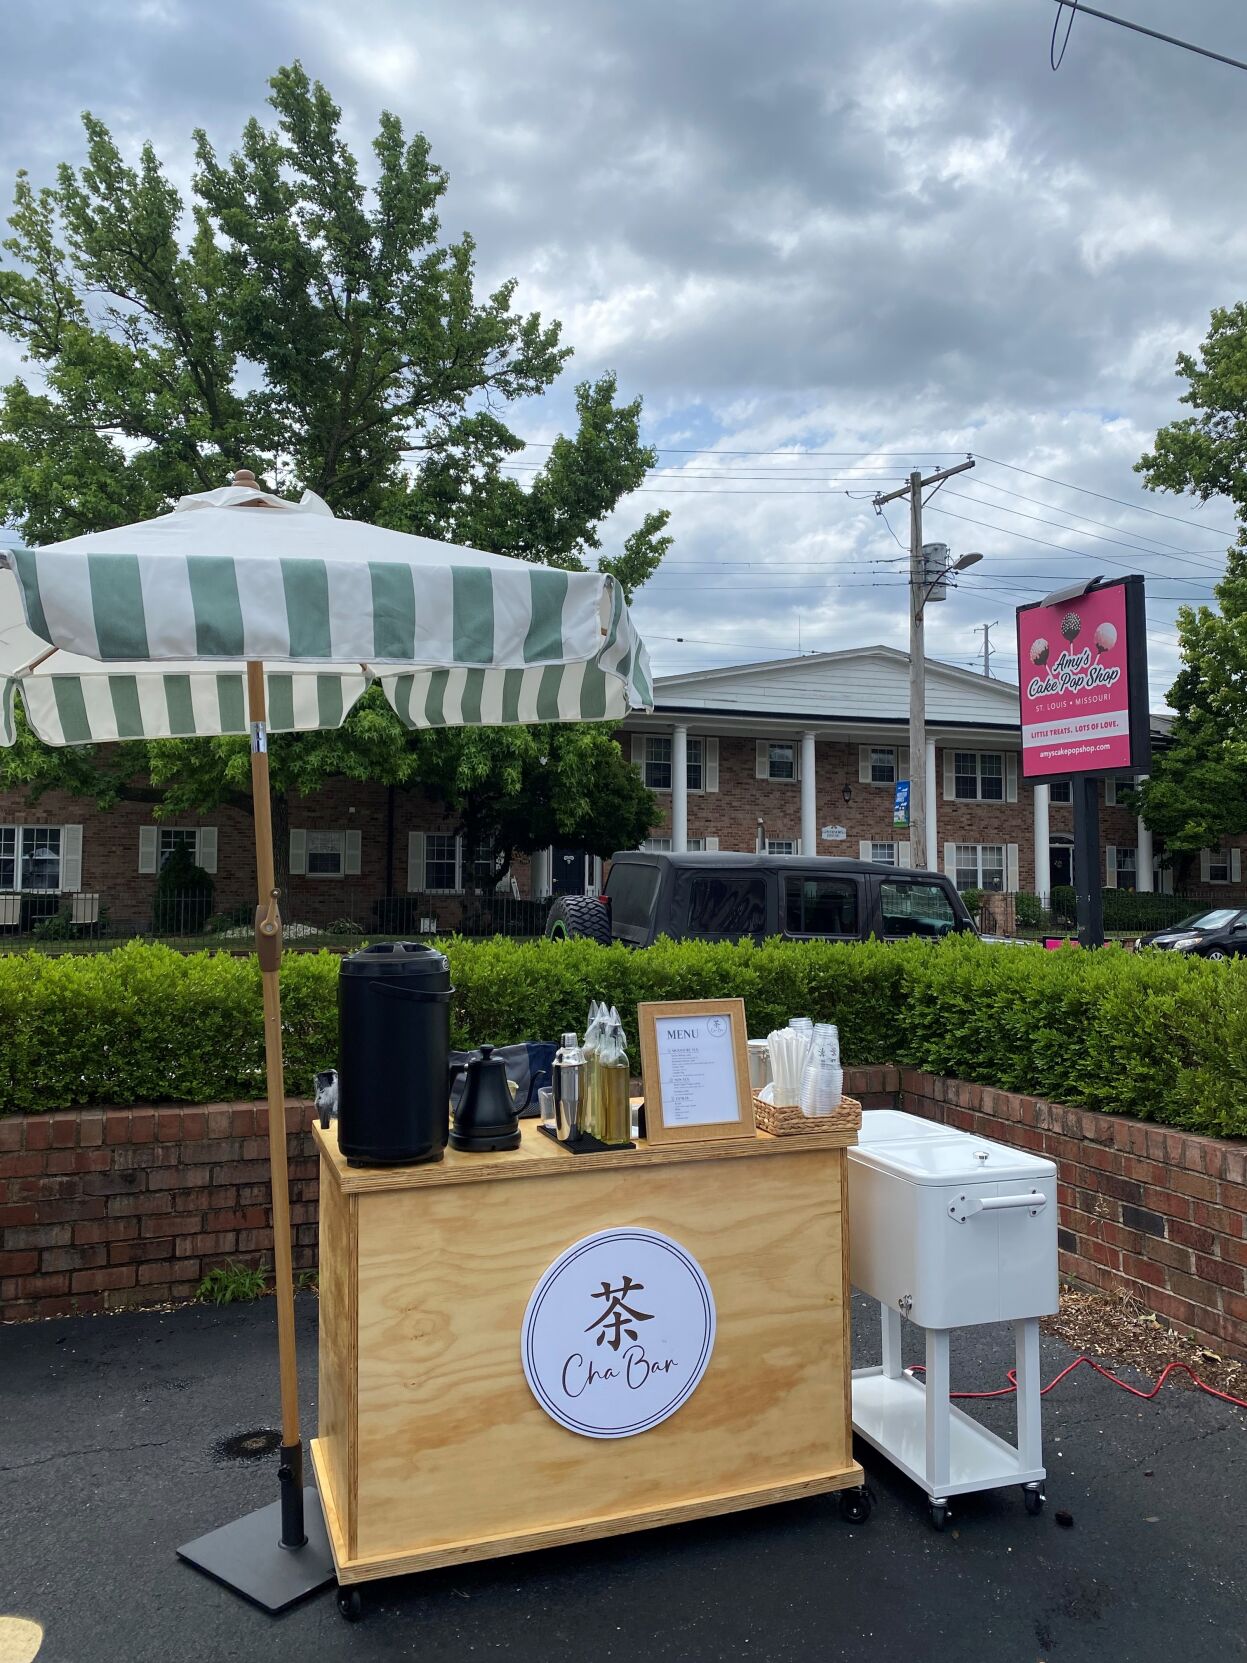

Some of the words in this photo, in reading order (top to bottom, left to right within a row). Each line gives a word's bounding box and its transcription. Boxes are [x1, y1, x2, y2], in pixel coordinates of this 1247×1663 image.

[1053, 649, 1090, 672] Amy's
[1029, 678, 1058, 697] Cake
[1059, 672, 1084, 692] Pop
[1086, 667, 1119, 687] Shop
[1047, 700, 1067, 711] LOUIS
[1075, 693, 1111, 705] MISSOURI
[1031, 729, 1049, 739] LITTLE
[1050, 727, 1073, 736] TREATS.
[1075, 724, 1090, 733] LOTS
[1091, 723, 1099, 731] OF
[1100, 720, 1119, 729] LOVE.
[1039, 743, 1111, 758] amyscakepopshop.com
[667, 1028, 699, 1040] MENU
[584, 1275, 655, 1351] 茶
[562, 1353, 620, 1398] Cha
[622, 1345, 678, 1390] Bar
